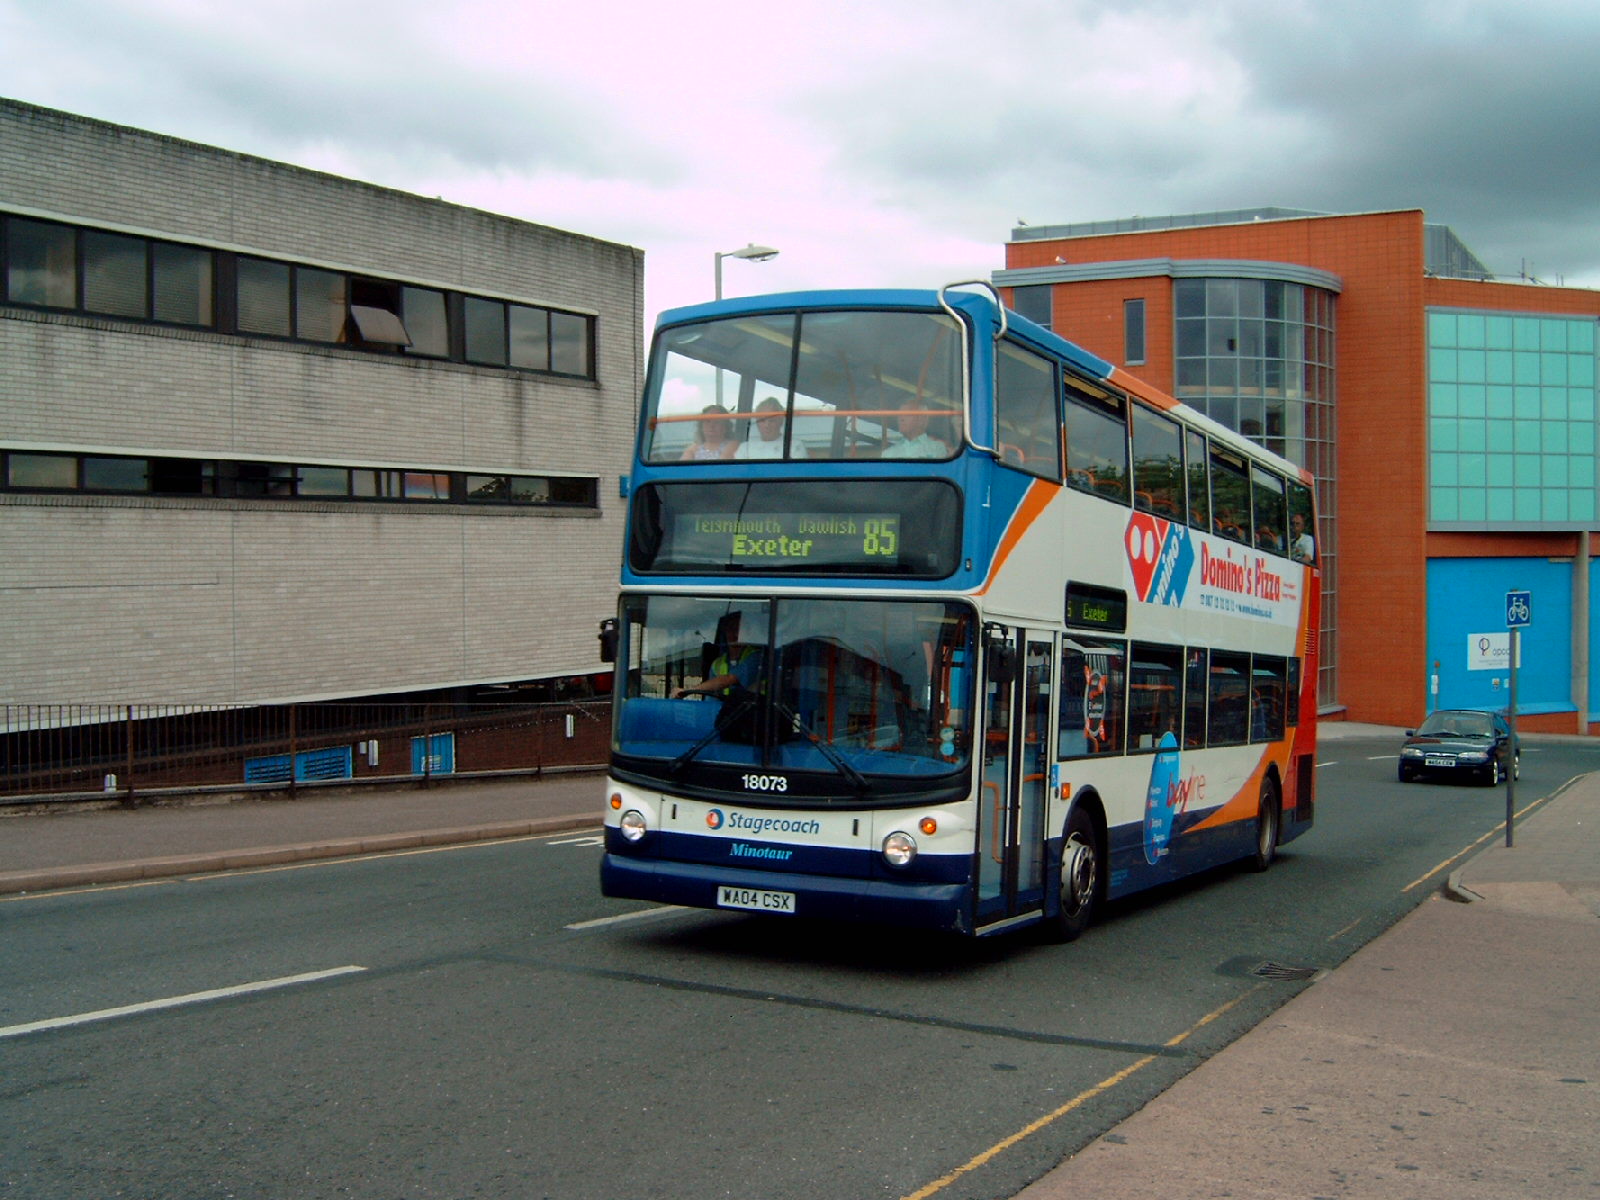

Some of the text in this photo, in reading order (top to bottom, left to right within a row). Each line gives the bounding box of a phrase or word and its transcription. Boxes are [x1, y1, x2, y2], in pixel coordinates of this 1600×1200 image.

[731, 534, 813, 557] Exeter
[863, 518, 897, 556] 85
[1200, 540, 1281, 603] Domino's Pizza
[741, 774, 788, 792] 18073
[728, 812, 820, 834] Stagecoach
[730, 843, 793, 861] Minotaur
[723, 889, 790, 910] WA04 CSX
